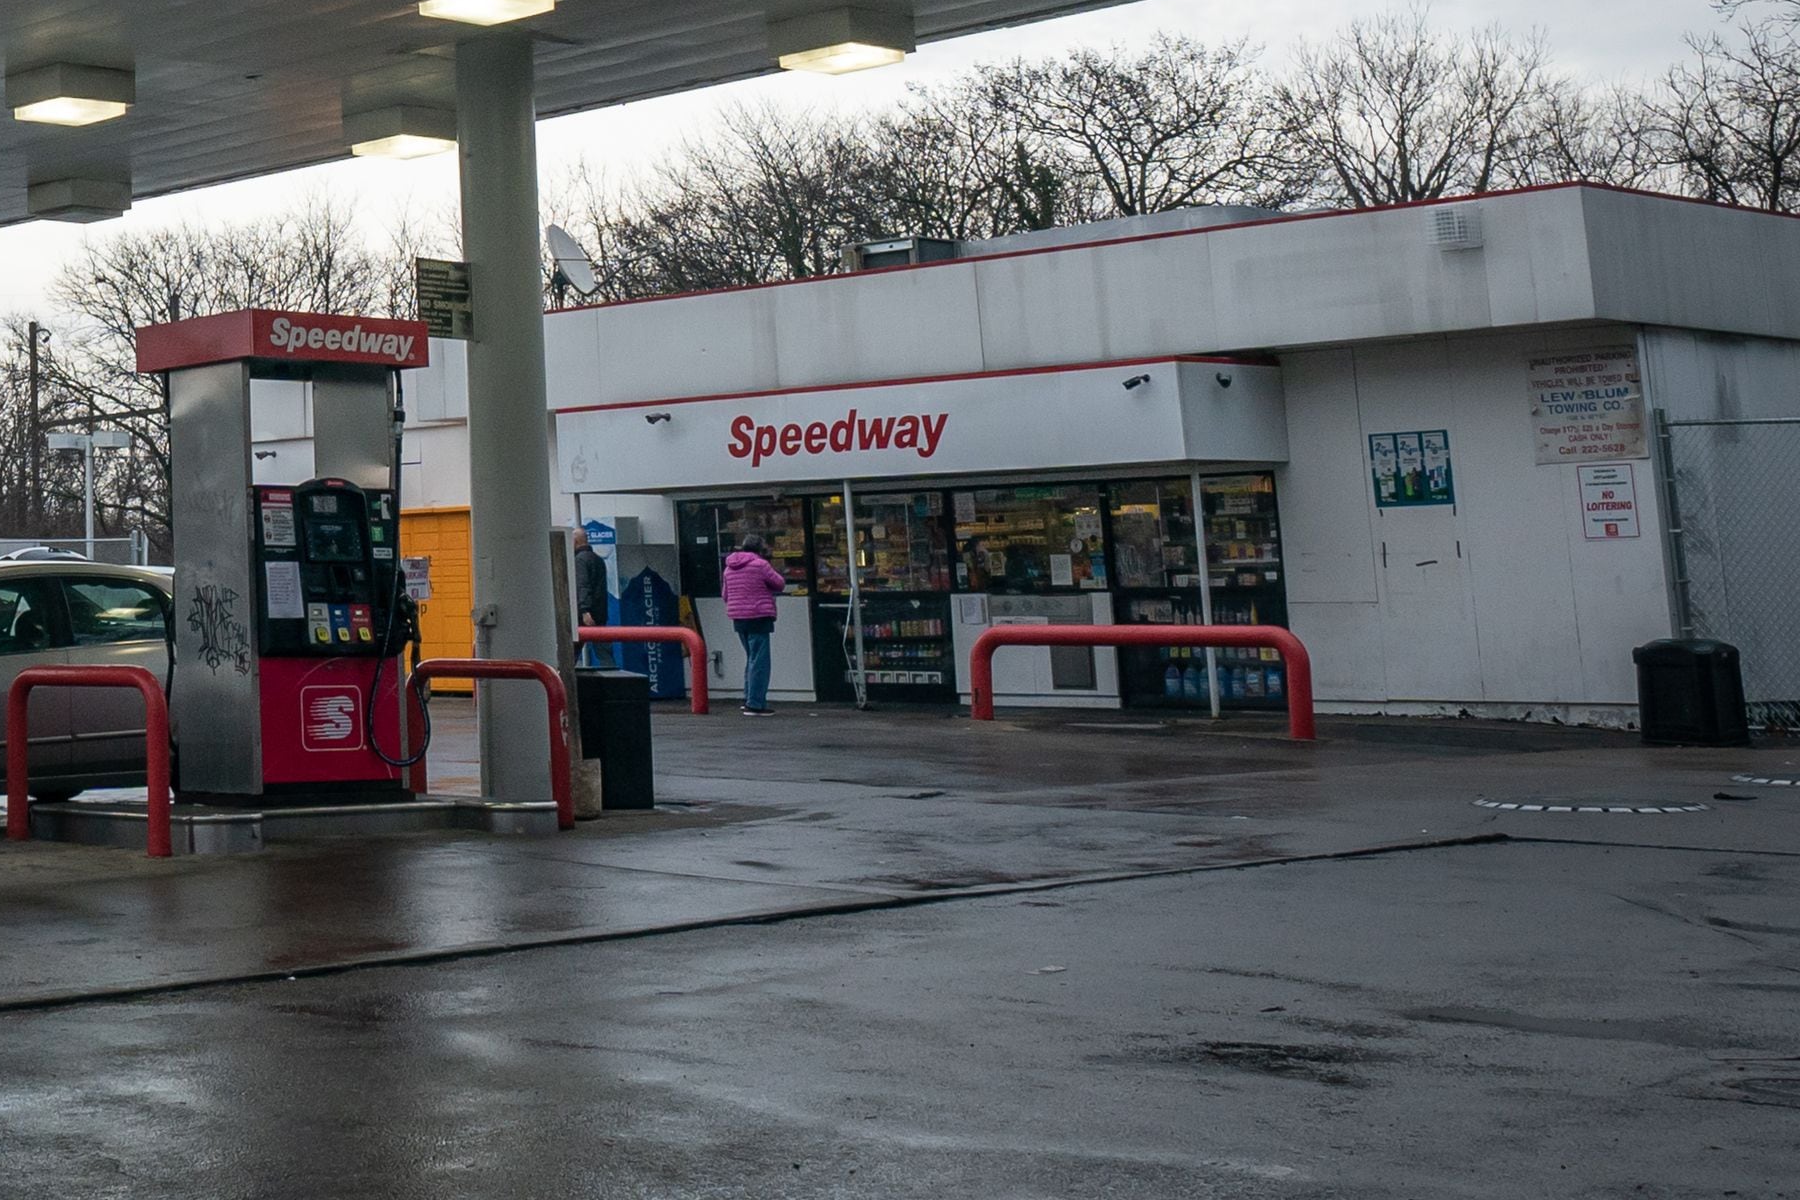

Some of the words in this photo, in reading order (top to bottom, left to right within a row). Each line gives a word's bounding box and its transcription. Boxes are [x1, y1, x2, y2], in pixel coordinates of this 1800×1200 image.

[270, 317, 416, 362] Speedway
[1567, 377, 1583, 387] WILL
[1585, 376, 1596, 386] BE
[1598, 374, 1622, 384] TOWED
[1541, 391, 1575, 403] LEW
[1583, 387, 1629, 400] BLUM
[1547, 402, 1598, 415] TOWING
[1603, 400, 1625, 411] CO.
[1602, 423, 1614, 432] Day
[727, 409, 949, 467] Speedway
[1568, 434, 1588, 442] CASH
[1559, 445, 1577, 455] Call
[1601, 490, 1615, 500] NO
[1586, 501, 1633, 512] LOITERING
[590, 531, 614, 539] GLACIER
[644, 575, 656, 625] LACIER
[647, 642, 660, 693] ARCTIC
